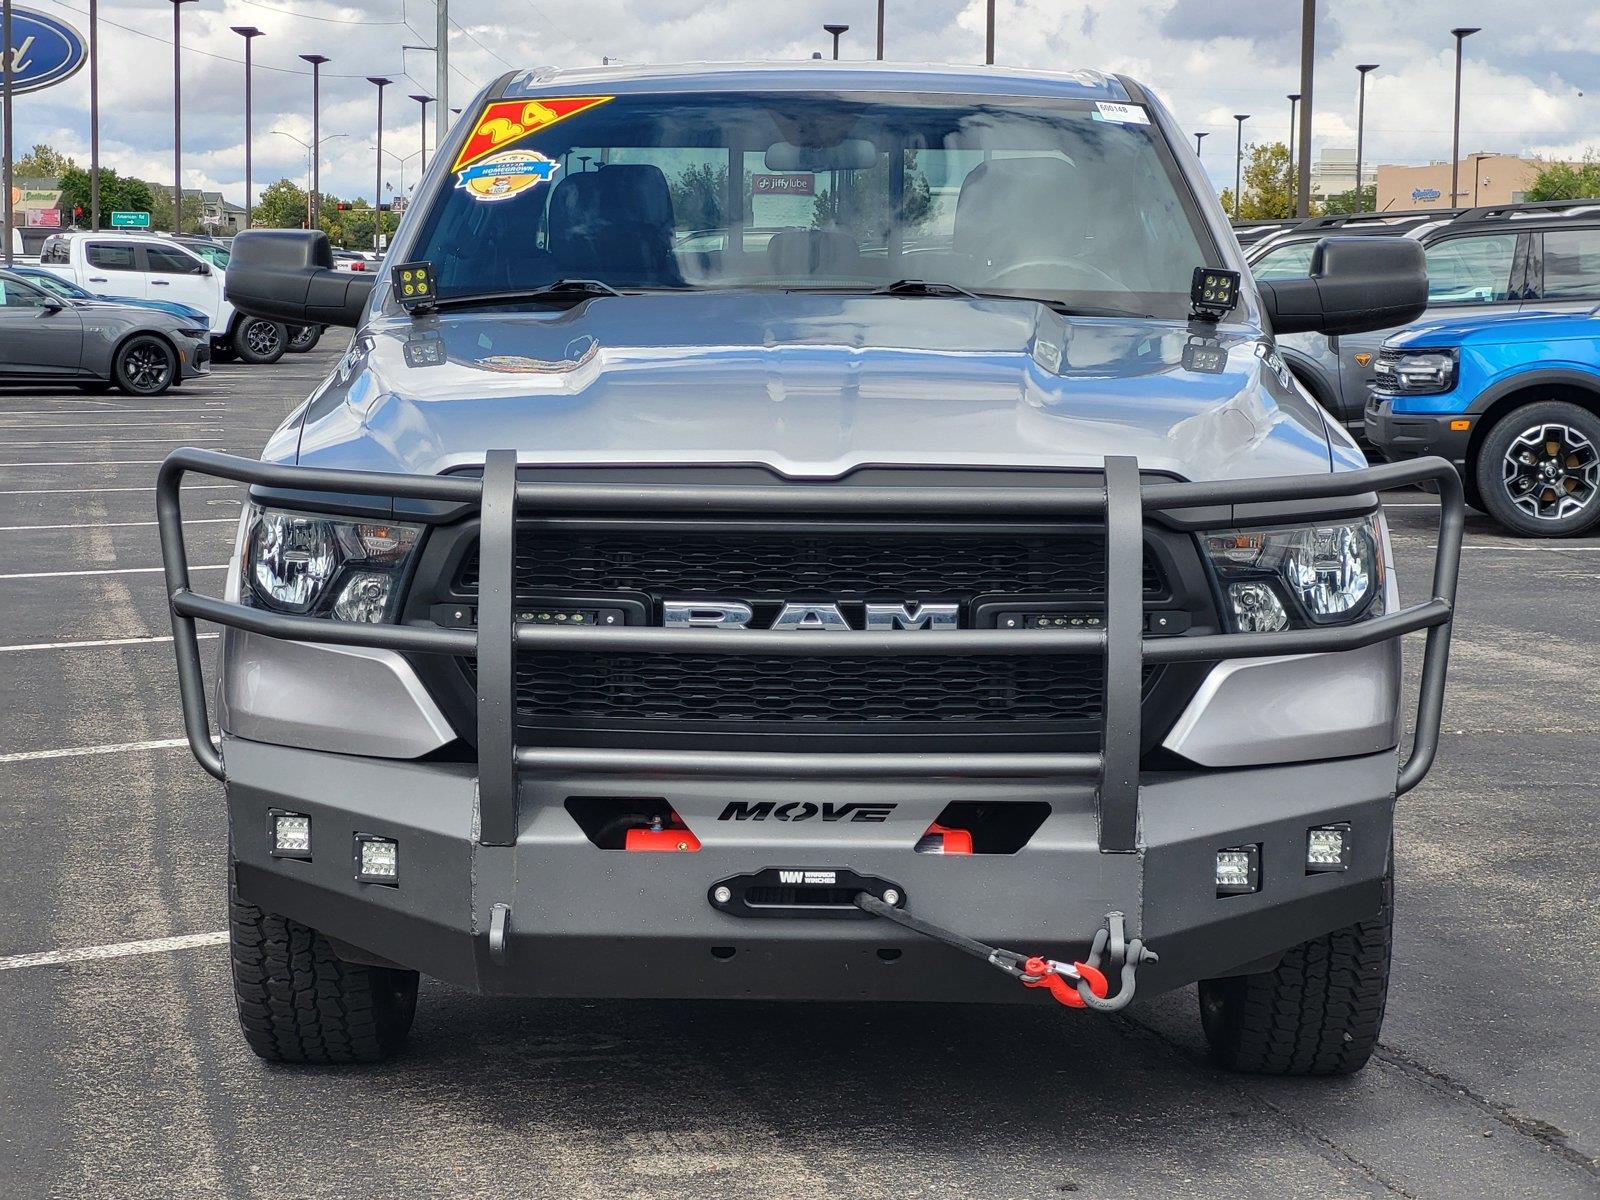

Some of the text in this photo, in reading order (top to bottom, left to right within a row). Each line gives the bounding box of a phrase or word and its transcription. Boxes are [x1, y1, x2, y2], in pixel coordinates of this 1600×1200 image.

[478, 102, 558, 144] 24
[482, 165, 534, 175] HOMEGROWN
[663, 600, 959, 631] RAM
[717, 801, 898, 822] MOVE
